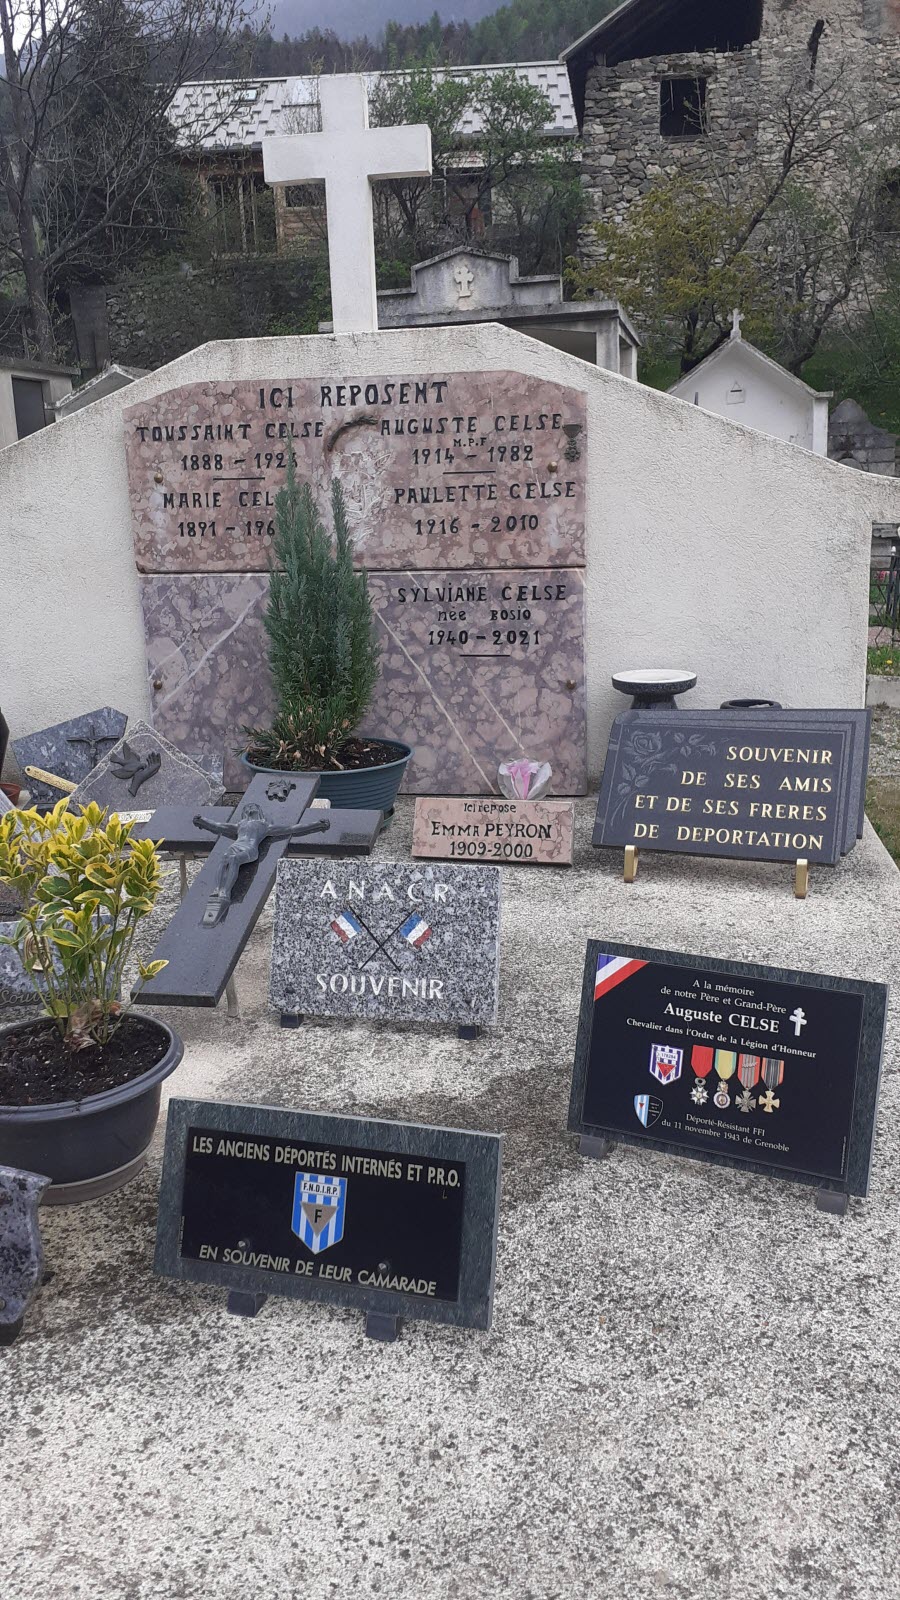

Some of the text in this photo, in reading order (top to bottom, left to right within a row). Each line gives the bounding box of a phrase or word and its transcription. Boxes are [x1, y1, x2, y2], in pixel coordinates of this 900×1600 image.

[259, 381, 448, 408] ICI REPOSENT
[136, 422, 323, 442] TOUSSAINT CELSE
[381, 414, 562, 435] AUGUSTE CELSE
[181, 454, 223, 470] 1888
[412, 448, 454, 464] 1914
[488, 445, 533, 462] 1982
[164, 492, 274, 508] MARIE CEL
[395, 482, 576, 504] PAULETTE CELSE
[178, 522, 216, 537] 1891
[246, 520, 276, 536] 196
[415, 518, 459, 535] 1916
[491, 515, 538, 532] 2010
[502, 585, 566, 601] CELSE
[429, 630, 468, 645] 1940
[493, 631, 539, 645] 2021
[727, 746, 833, 765] SOUVENIR
[681, 771, 832, 793] DE SES AMIS
[464, 803, 516, 814] Ici repose
[635, 795, 827, 821] ET DE SES FRERES
[484, 823, 552, 839] PEYRON
[634, 823, 823, 850] DE DEPORTATION
[450, 841, 532, 858] 1909-2000
[316, 973, 444, 999] SOUVENIR
[693, 979, 754, 996] A la mémoire
[660, 985, 787, 1014] de notre Père et Grand-Père
[663, 1003, 780, 1033] Auguste CELSE
[626, 1018, 816, 1058] Chevalier dans l'Ordre de la Légion d'Honneur
[662, 1118, 789, 1152] du 11 novembre 1943 de Grenoble
[686, 1113, 765, 1137] Déporté-Résistant FFI
[193, 1136, 460, 1187] LES ANCIENS DÉPORTÉS INTERNÉS ET P.R.O.
[314, 1209, 322, 1224] F
[199, 1244, 436, 1296] EN SOUVENIR DE LEUR CAMARADE
